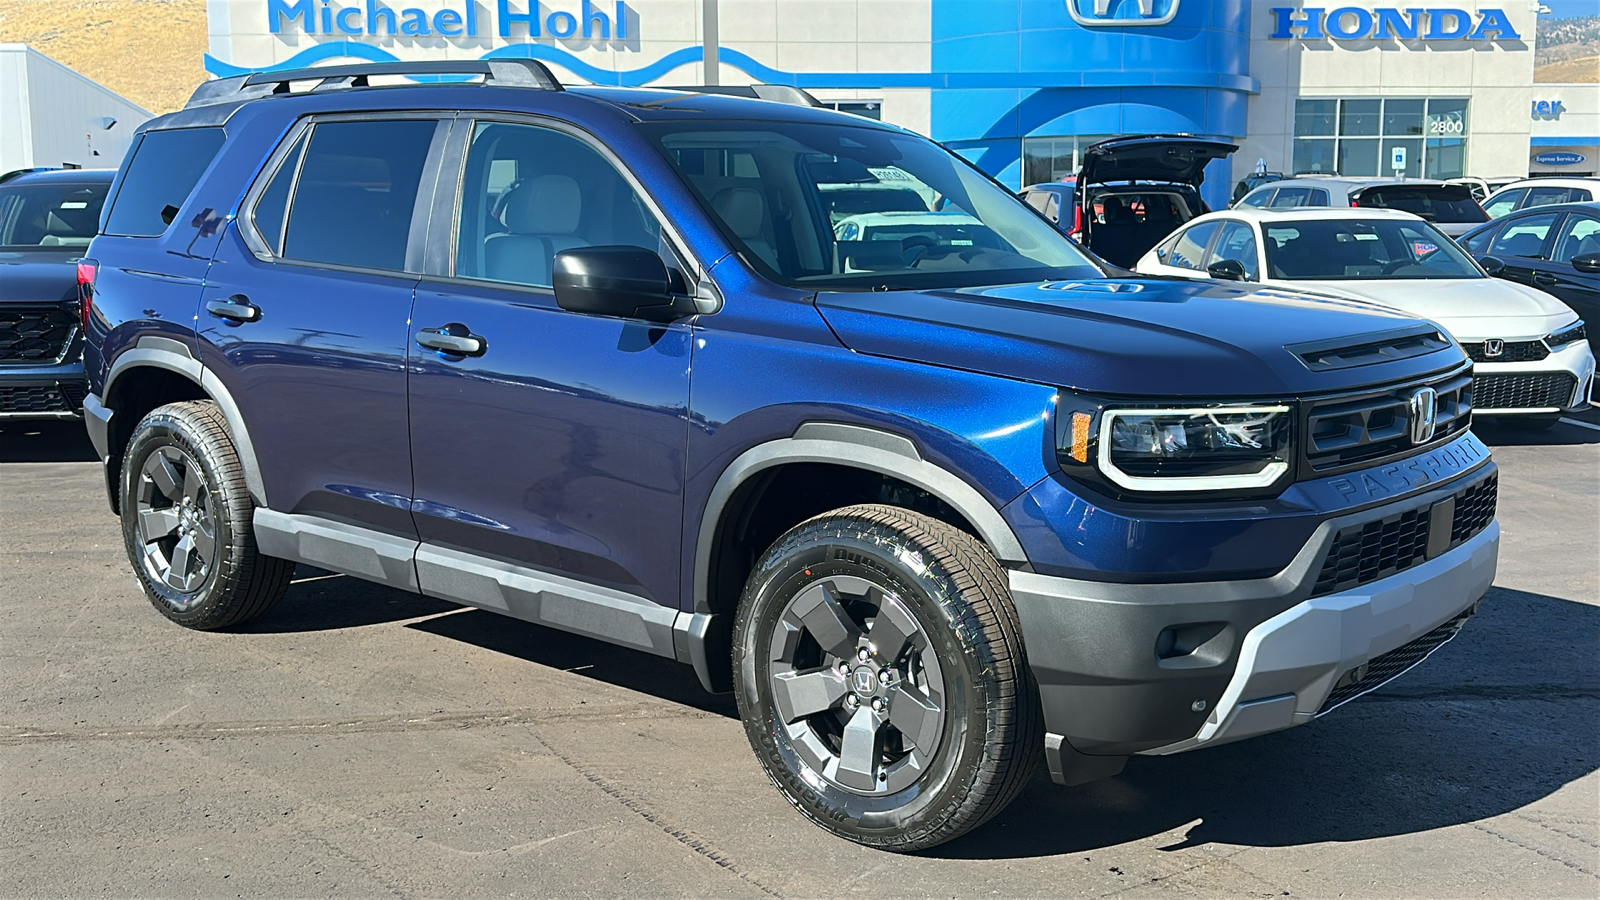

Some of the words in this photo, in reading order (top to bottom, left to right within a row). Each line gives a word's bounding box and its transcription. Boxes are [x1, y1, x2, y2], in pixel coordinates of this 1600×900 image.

[268, 0, 477, 37] Michael
[498, 0, 627, 39] Hohl
[1270, 7, 1521, 40] HONDA
[1430, 121, 1463, 133] 2800
[1327, 437, 1481, 503] PASSPORT
